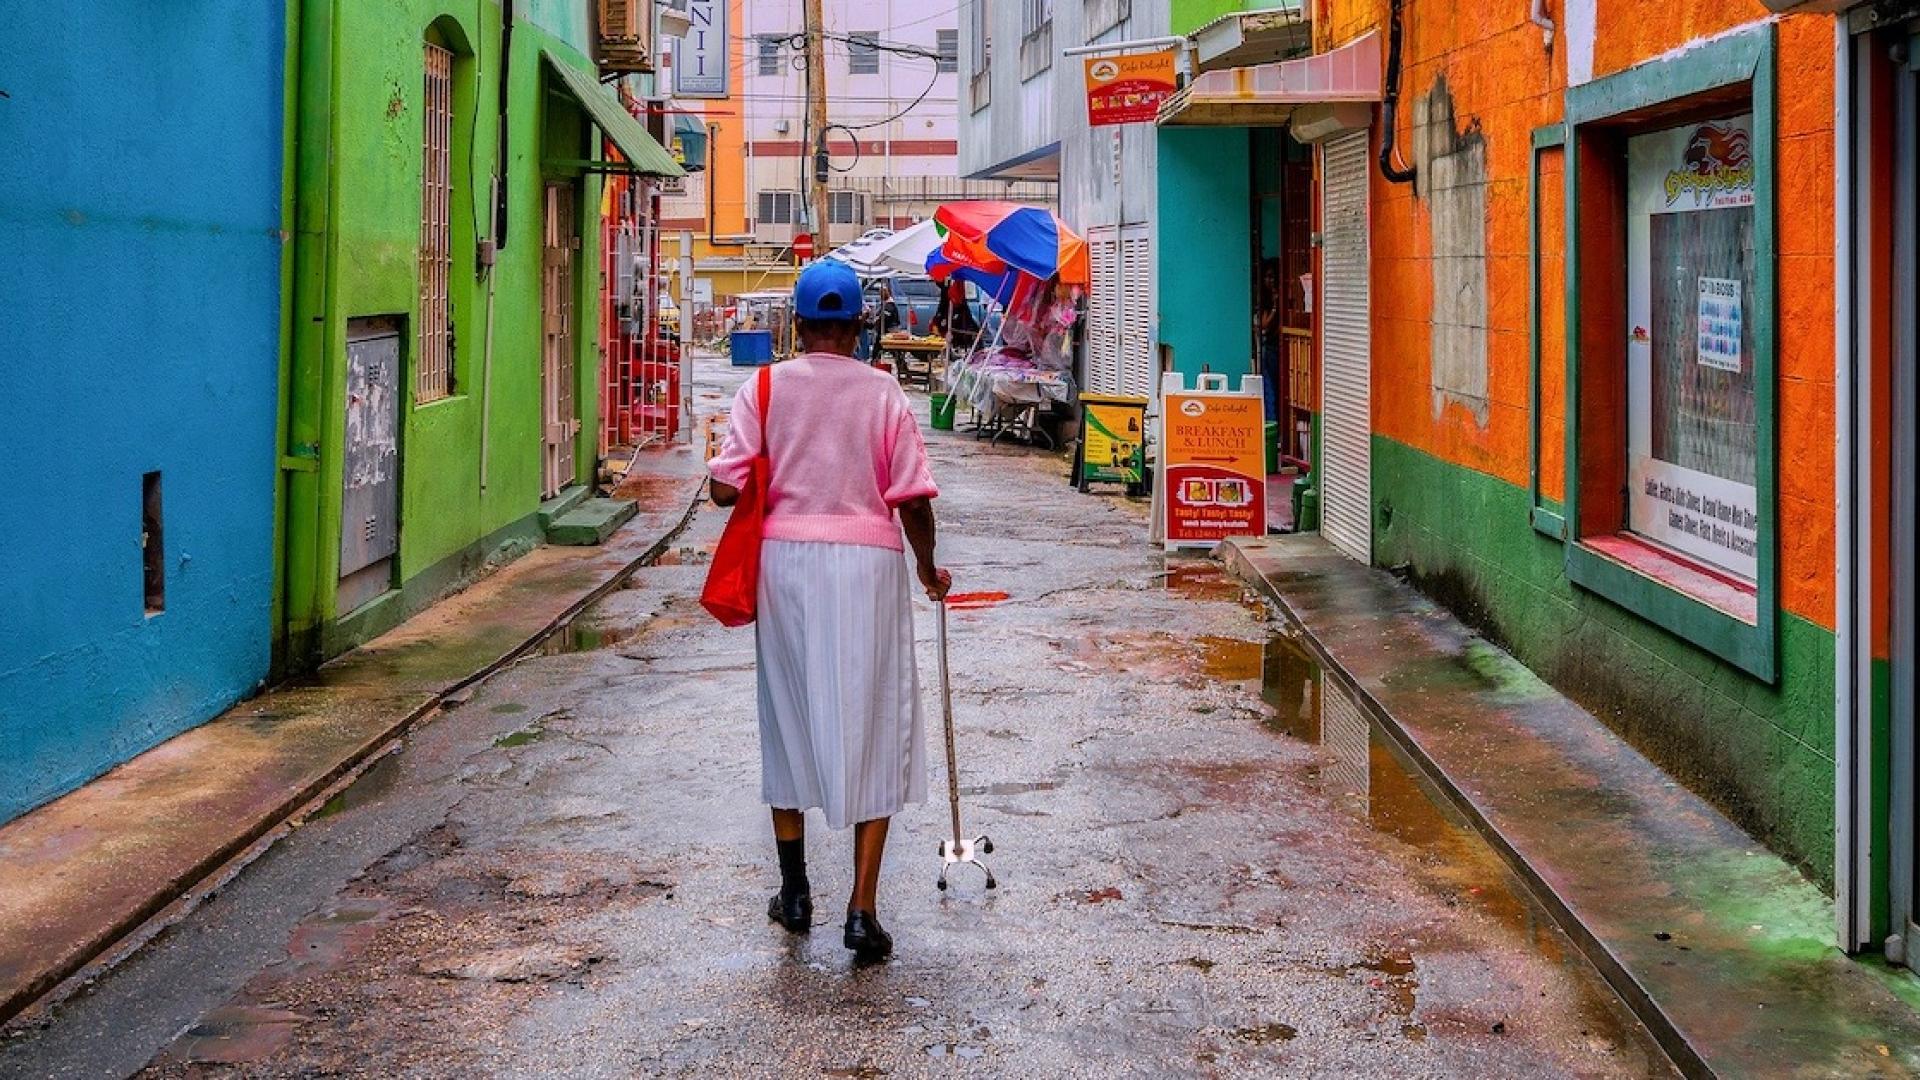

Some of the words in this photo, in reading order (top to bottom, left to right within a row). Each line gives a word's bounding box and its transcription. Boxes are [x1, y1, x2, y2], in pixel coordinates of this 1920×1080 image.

[1175, 425, 1254, 438] BREAKFAST
[1184, 437, 1195, 447] &
[1198, 437, 1246, 448] LUNCH
